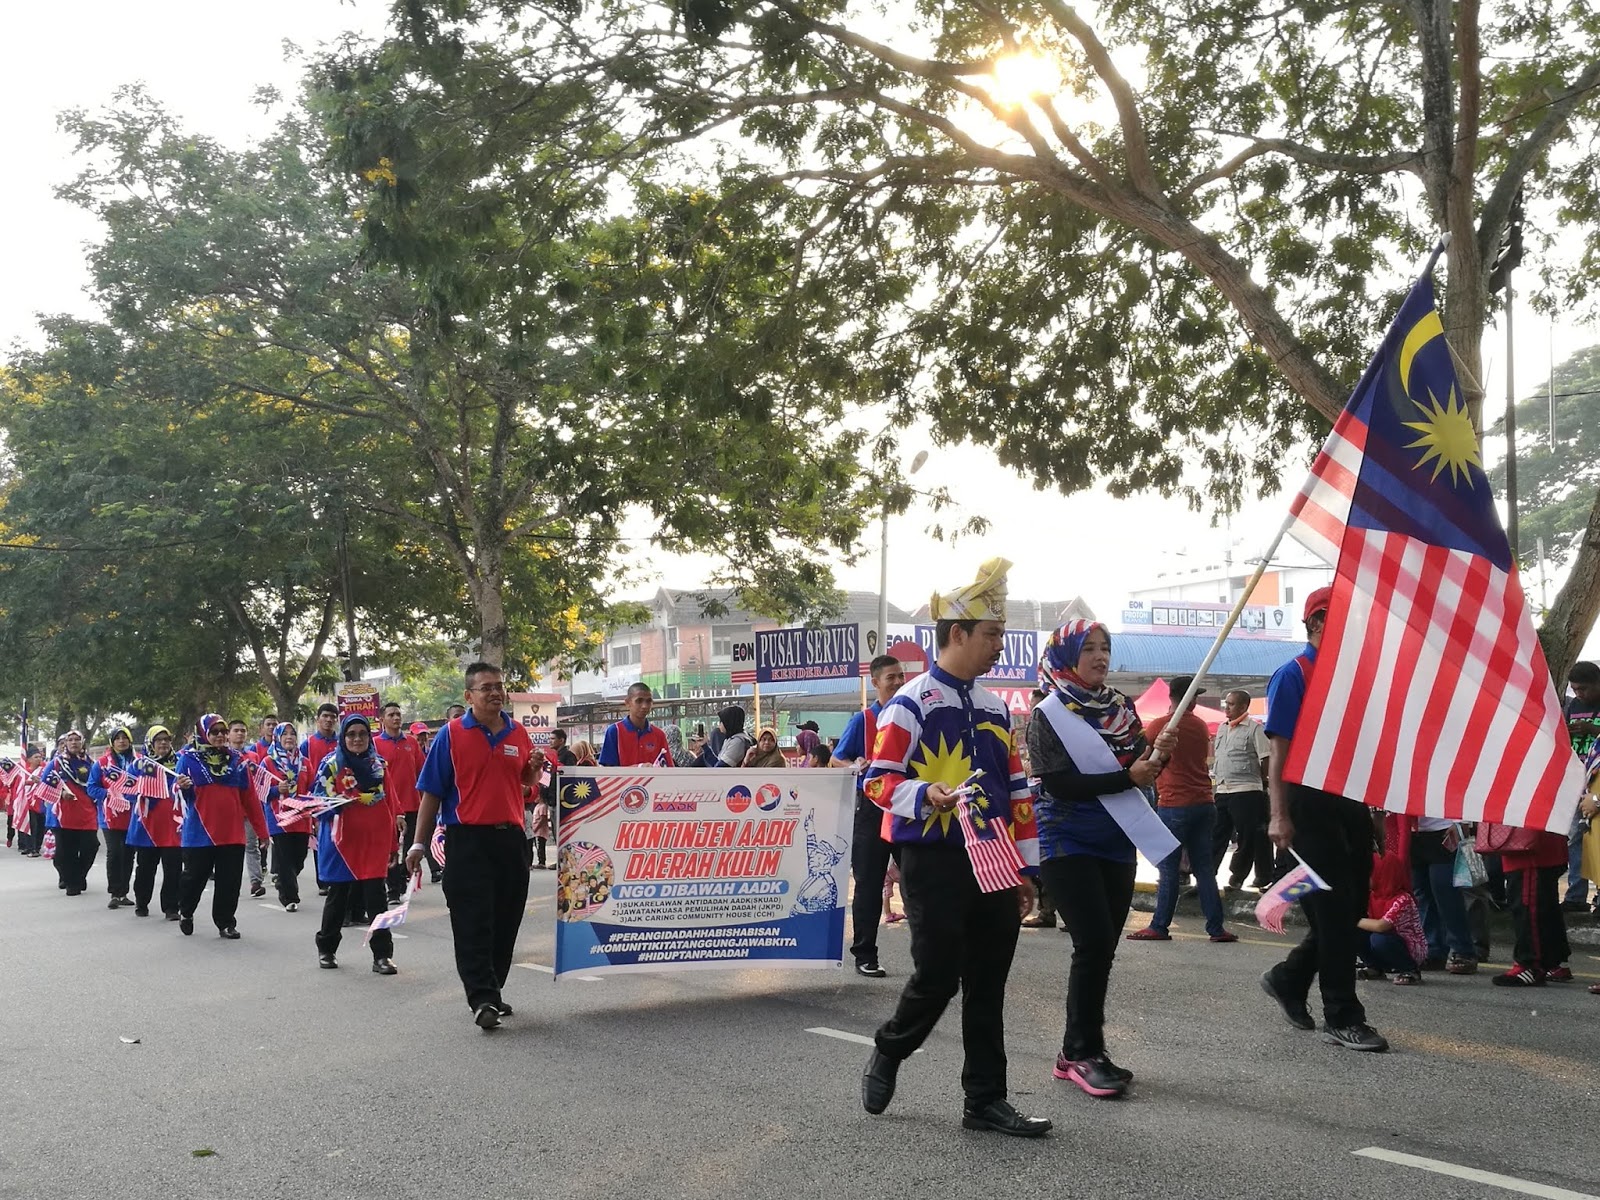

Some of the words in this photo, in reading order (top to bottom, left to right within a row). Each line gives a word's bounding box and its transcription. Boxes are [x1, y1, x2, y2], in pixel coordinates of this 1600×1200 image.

[1129, 601, 1143, 609] EON
[733, 642, 754, 662] EON
[760, 631, 803, 668] PUSAT
[806, 626, 856, 665] SERVIS
[771, 664, 849, 680] KENDERAAN
[345, 702, 374, 712] FITRAH
[522, 715, 549, 727] EON
[614, 820, 739, 850] KONTINJEN
[735, 819, 798, 848] AADK
[624, 850, 717, 881] DAERAH
[713, 848, 783, 879] KULIM
[618, 885, 657, 898] NGO
[660, 883, 735, 897] DIBAWAH
[737, 881, 783, 894] AADK
[616, 900, 682, 909] 1)SUKARELAWAN
[684, 898, 729, 906] ANTIDADAH
[730, 896, 782, 904] AADK(SKUAD)
[612, 907, 683, 917] 2)JAWATANKUASA
[684, 905, 729, 913] PEMULIHAN
[645, 914, 675, 922] CARING
[677, 912, 724, 920] COMMUNITY
[608, 927, 781, 942] #PERANGIDADAHHABISHABISAN
[589, 937, 798, 955] #KOMUNITIKITATANGGUNGJAWABKITA
[637, 948, 750, 962] #HIDUPTANPADADAH
